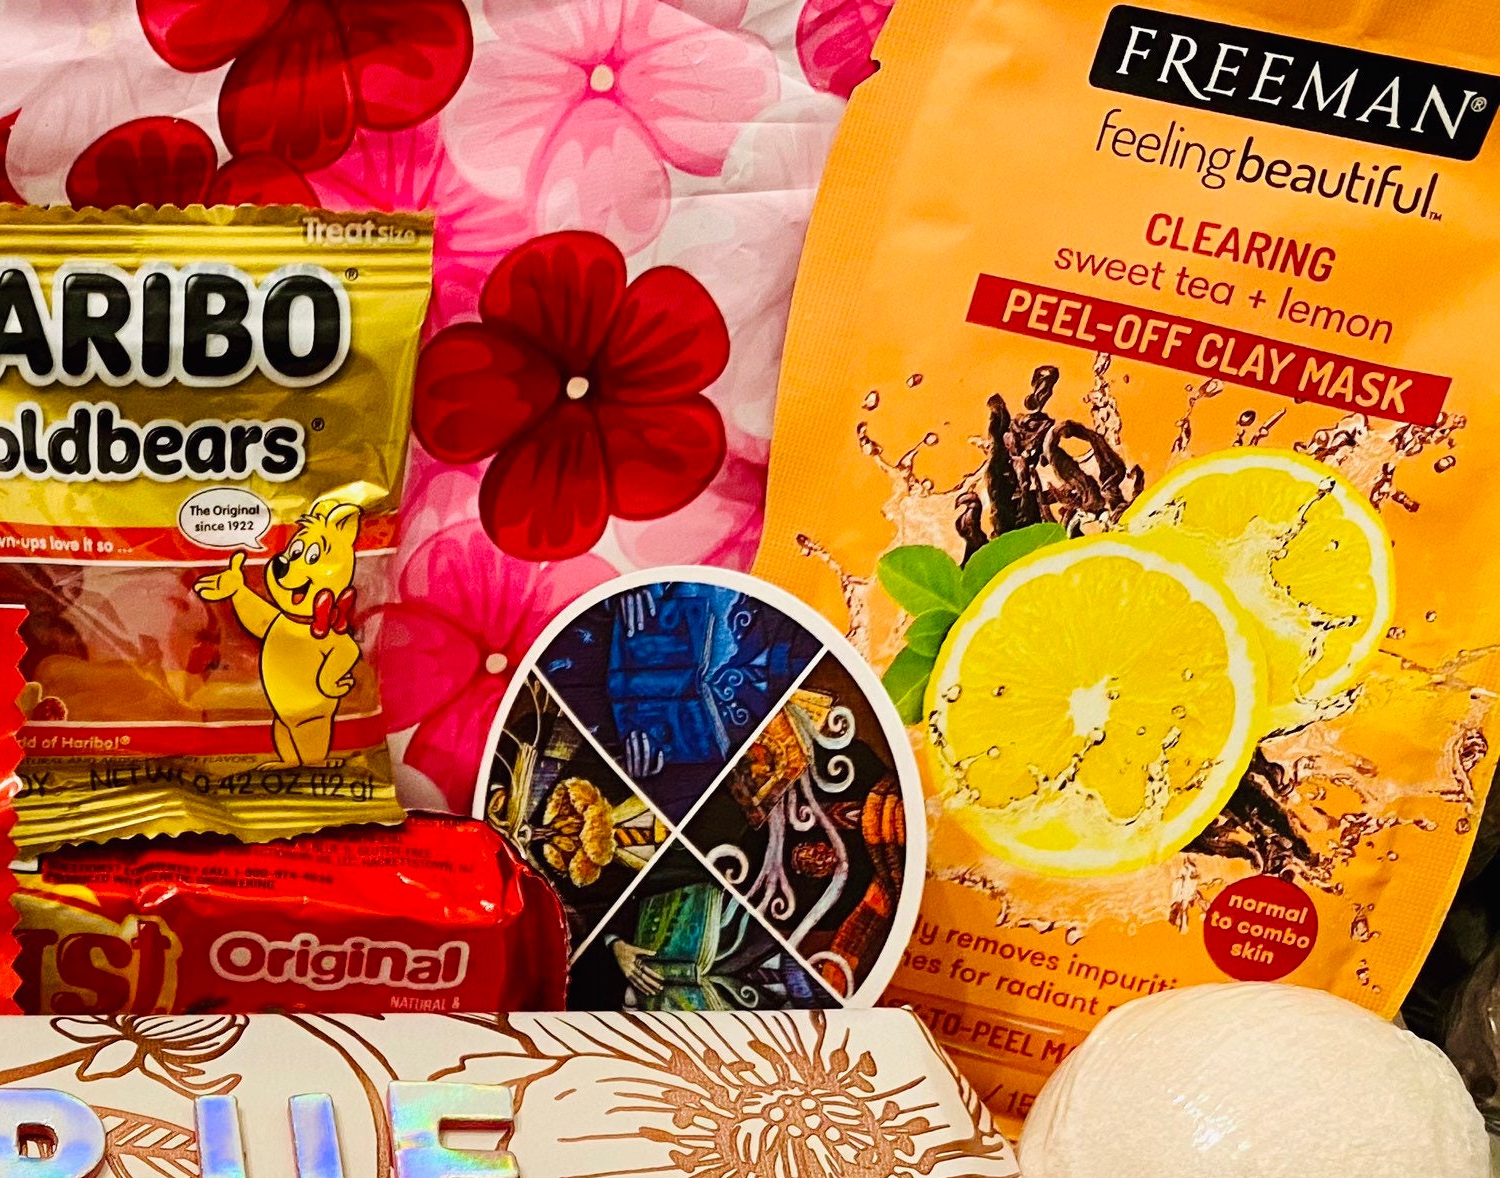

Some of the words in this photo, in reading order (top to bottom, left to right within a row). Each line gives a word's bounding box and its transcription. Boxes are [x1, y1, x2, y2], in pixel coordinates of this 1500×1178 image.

[303, 216, 375, 243] Treat
[377, 225, 415, 243] size
[1146, 213, 1336, 283] CLEARING
[1054, 247, 1165, 290] sweet
[1176, 266, 1235, 307] tea
[1278, 287, 1393, 344] lemon
[1001, 288, 1193, 359] PEEL-OFF
[1195, 333, 1296, 385] CLAY
[1298, 357, 1414, 414] MASK
[190, 505, 211, 516] The
[213, 504, 260, 518] Original
[195, 521, 224, 532] since
[228, 520, 254, 531] 1922
[50, 536, 80, 552] love
[83, 537, 93, 552] it
[97, 541, 114, 553] so
[41, 735, 59, 749] of
[90, 765, 142, 791] NET
[193, 772, 254, 796] 0.42
[261, 773, 303, 796] OZ
[1228, 894, 1309, 924] normal
[1210, 910, 1232, 930] to
[1237, 921, 1311, 949] combo
[212, 932, 468, 990] Original
[946, 926, 1060, 971] removes
[1230, 941, 1274, 964] skin
[950, 957, 990, 987] for
[996, 974, 1100, 1017] radiant
[390, 996, 447, 1011] NATURAL
